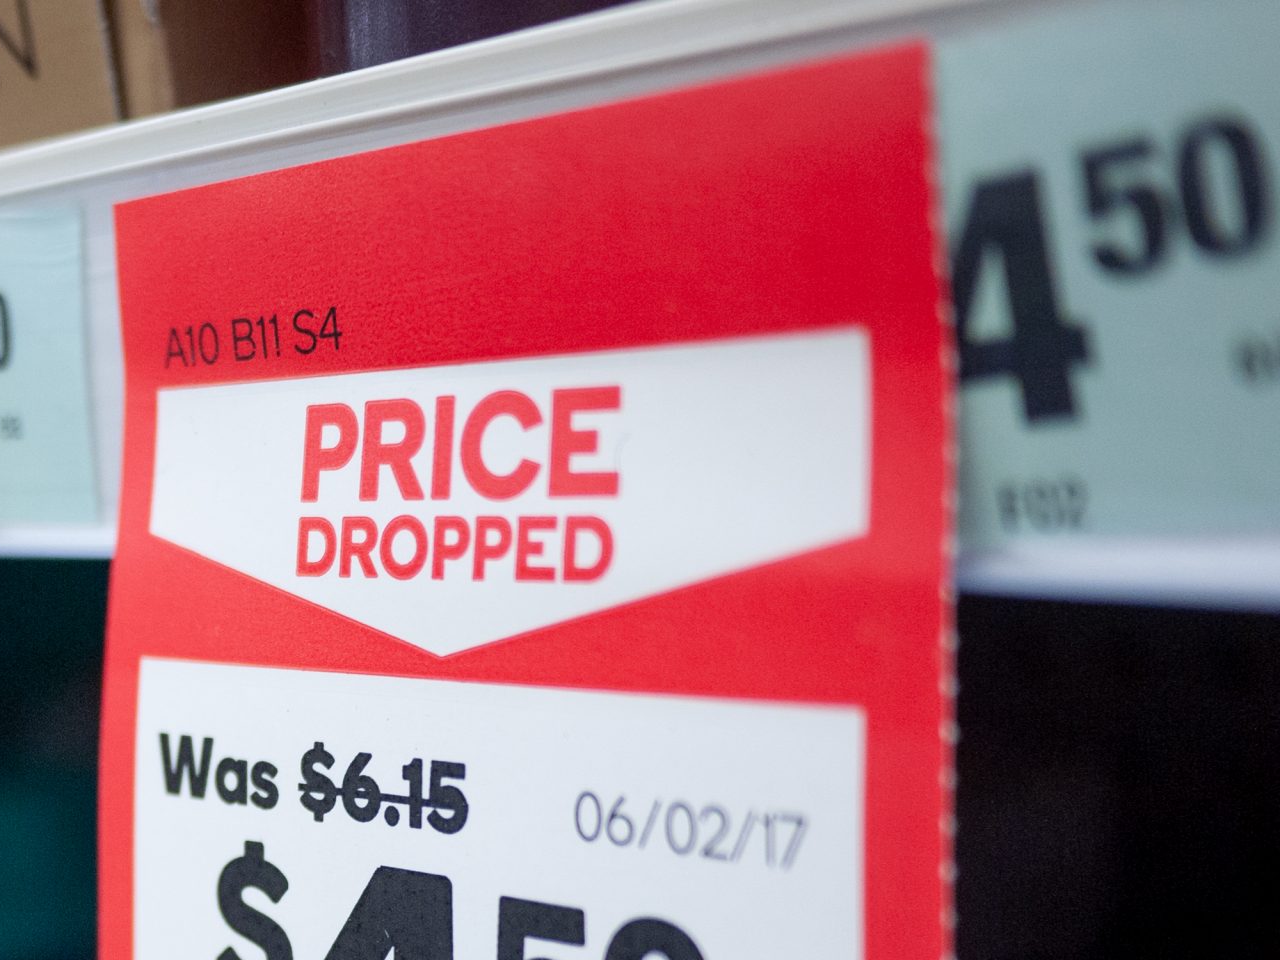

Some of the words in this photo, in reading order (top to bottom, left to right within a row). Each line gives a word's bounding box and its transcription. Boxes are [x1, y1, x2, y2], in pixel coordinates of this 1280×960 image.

[164, 322, 219, 369] A10
[292, 305, 343, 356] S4
[300, 385, 622, 503] PRICE
[295, 514, 616, 584] DROPPED
[158, 731, 279, 809] Was
[297, 741, 470, 835] $6.15
[574, 789, 809, 872] 06/02/17
